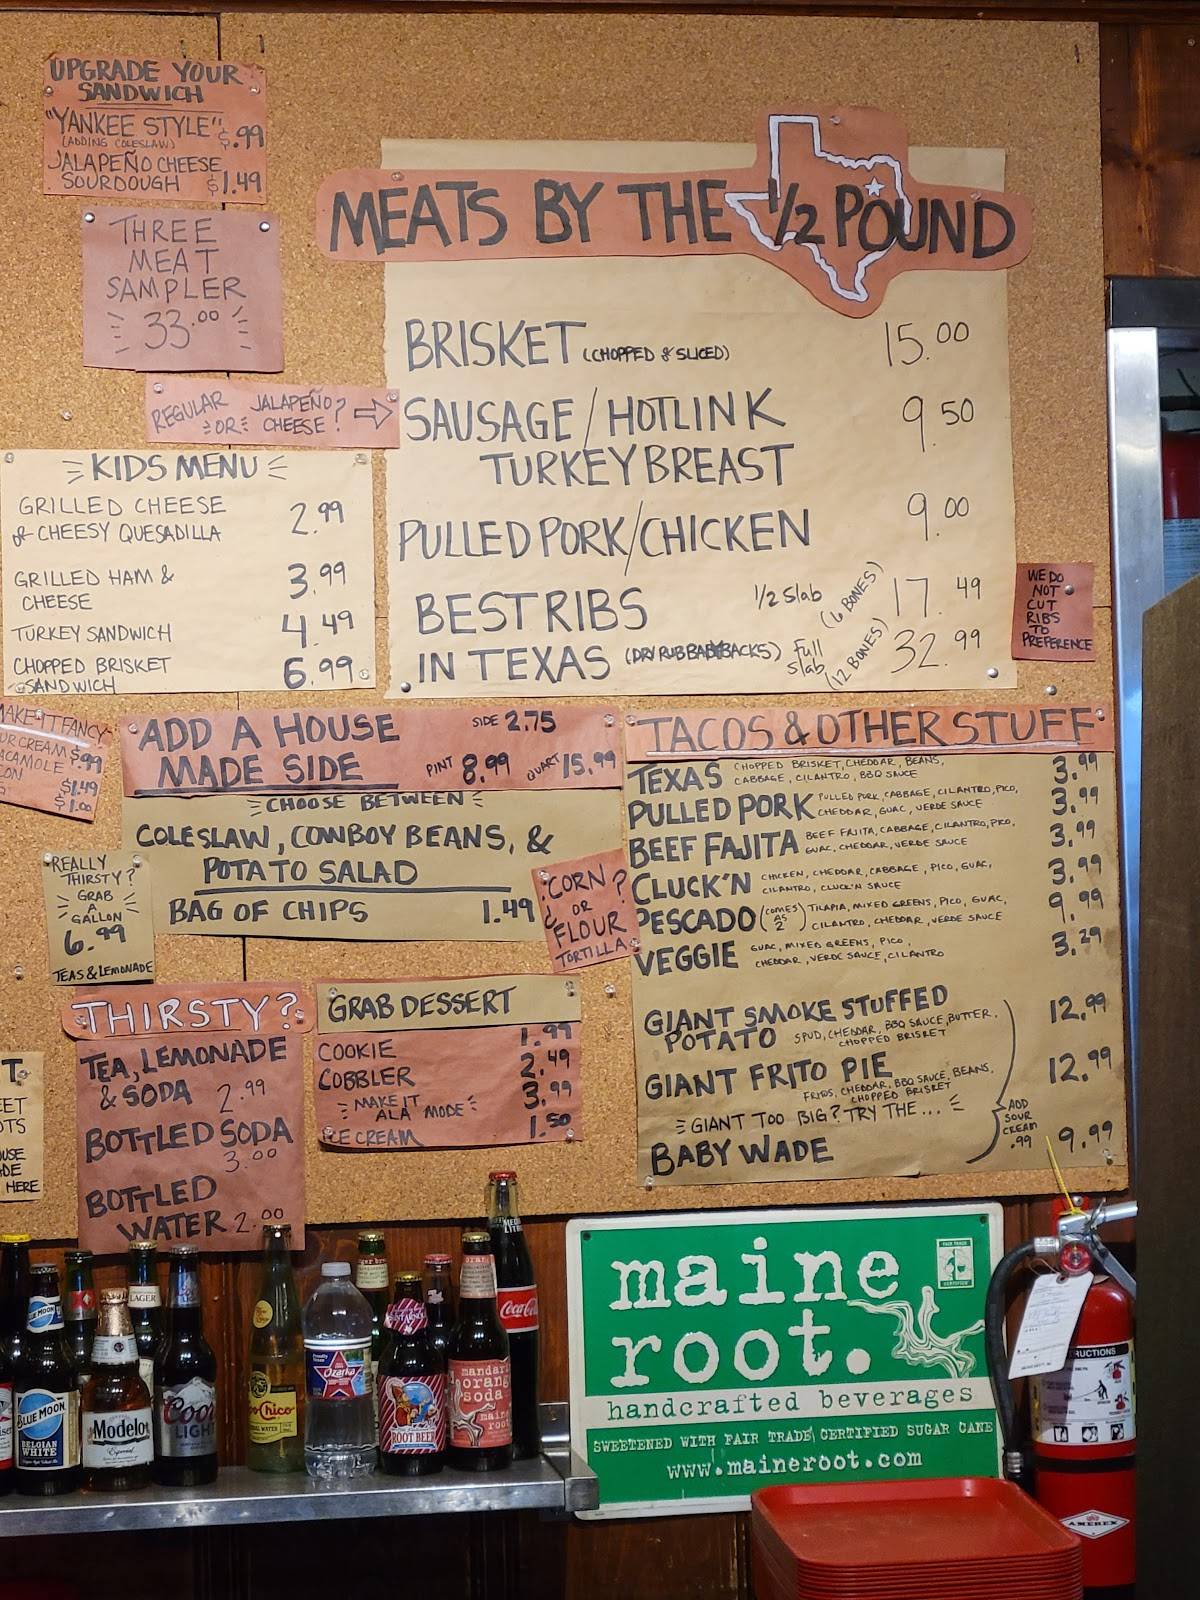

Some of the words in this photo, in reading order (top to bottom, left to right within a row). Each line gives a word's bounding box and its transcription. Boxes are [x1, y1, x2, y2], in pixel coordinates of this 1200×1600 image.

[50, 59, 160, 83] UPGRADE
[171, 60, 243, 85] YOUR
[78, 82, 204, 104] SANDWICH
[157, 155, 222, 173] CHEESE
[62, 172, 180, 192] SOURDOUGH
[108, 213, 217, 245] THREE
[330, 180, 508, 255] MEATS
[533, 178, 604, 244] BY
[617, 178, 732, 244] THE
[835, 184, 1016, 259] POUND
[129, 247, 220, 275] MEAT
[106, 275, 247, 304] SAMPLER
[405, 318, 588, 373] BRISKET
[151, 390, 230, 434] REGULAR
[91, 452, 168, 482] KIDS
[175, 455, 259, 482] MENU
[479, 443, 637, 488] TURKEY
[645, 442, 795, 487] BREAST
[19, 496, 123, 516] GRILLED
[134, 495, 227, 515] CHEESE
[289, 500, 345, 537] 2.99
[38, 521, 110, 543] CHEESY
[119, 522, 222, 543] QUESADILLA
[398, 518, 532, 562] PULLED
[14, 569, 101, 587] GRILLED
[107, 569, 155, 587] HAM
[159, 563, 175, 585] &
[287, 560, 347, 600] 3.99
[1027, 570, 1048, 583] WE
[1048, 571, 1065, 584] DO
[21, 592, 94, 612] CHEESE
[1031, 584, 1057, 599] NOT
[415, 590, 539, 636] BEST
[545, 586, 648, 633] RIBS
[1026, 599, 1057, 612] CUT
[1026, 611, 1062, 625] RIBS
[11, 623, 82, 643] TURKEY
[87, 623, 173, 642] SANDWICH
[1029, 625, 1050, 635] TO
[13, 656, 86, 675] CHOPPED
[95, 656, 172, 675] BRISKET
[418, 650, 456, 684] IN
[467, 644, 611, 685] TEXAS
[659, 644, 686, 662] RUB
[138, 717, 213, 753] ADD
[231, 717, 263, 753] A
[273, 712, 401, 748] HOUSE
[472, 714, 500, 729] SIDE
[504, 709, 557, 734] 2.75
[637, 714, 775, 754] TACOS
[784, 714, 811, 747] &
[816, 708, 948, 748] OTHER
[952, 706, 1096, 746] STUFF
[156, 754, 265, 790] MADE
[284, 751, 364, 783] SIDE
[426, 757, 455, 779] PINT
[461, 752, 511, 786] 8.99
[627, 761, 724, 796] TEXAS
[734, 760, 784, 772] CHOPPED
[885, 769, 919, 779] SAUCE
[265, 794, 347, 813] CHOOSE
[360, 790, 465, 812] BETWEEN
[627, 796, 733, 831] PULLED
[738, 792, 817, 826] PORK
[915, 800, 947, 812] VERDE
[950, 798, 984, 810] SAUCE
[526, 825, 554, 855] &
[628, 834, 698, 871] BEEF
[704, 828, 800, 868] FAJITA
[805, 829, 836, 841] BEEF
[893, 837, 930, 849] VERDE
[934, 837, 969, 847] SAUCE
[52, 853, 107, 873] REALLY
[203, 858, 308, 886] POTATO
[319, 859, 419, 885] SALAD
[77, 889, 114, 902] GRAB
[631, 871, 751, 906] CLUCK'N
[866, 881, 902, 891] SAUCE
[71, 911, 123, 924] GALLON
[87, 903, 97, 914] A
[169, 897, 222, 926] BAG
[232, 899, 269, 923] OF
[283, 899, 369, 923] CHIPS
[482, 897, 536, 924] 1.49
[572, 899, 593, 916] OR
[636, 905, 757, 936] PESCADO
[852, 899, 889, 911] MIXED
[967, 911, 1003, 922] SAUCE
[553, 911, 628, 949] FLOUR
[555, 937, 628, 968] TORTILLA
[635, 940, 739, 977] VEGGIE
[785, 939, 822, 951] MIXED
[52, 967, 85, 983] TEAS
[86, 965, 99, 981] &
[327, 992, 396, 1024] GRAB
[400, 984, 518, 1020] DESSERT
[643, 1005, 736, 1037] GIANT
[744, 999, 837, 1028] SMOKE
[841, 983, 949, 1019] STUFFED
[317, 1038, 398, 1062] COOKIE
[664, 1026, 777, 1055] POTATO
[140, 1036, 288, 1074] LEMONADE
[317, 1065, 417, 1092] COBBLER
[645, 1067, 738, 1101] GIANT
[749, 1058, 828, 1091] FRITO
[841, 1050, 893, 1083] PIE
[100, 1083, 118, 1111] &
[122, 1079, 193, 1109] SODA
[353, 1095, 398, 1113] MAKE
[402, 1094, 421, 1109] IT
[851, 1090, 899, 1104] CHOPPED
[1008, 1099, 1029, 1111] ADD
[374, 1107, 412, 1123] ALA
[690, 1113, 746, 1134] GIANT
[751, 1111, 785, 1129] TOO
[843, 1105, 877, 1123] TRY
[1002, 1121, 1038, 1136] CREAM
[1004, 1110, 1033, 1122] SOUR
[84, 1121, 215, 1164] BOTTLED
[220, 1116, 295, 1149] SODA
[650, 1137, 732, 1177] BABY
[738, 1133, 834, 1165] WADE
[6, 1180, 41, 1194] HERE
[84, 1174, 218, 1220] BOTTLED
[116, 1210, 228, 1242] WATER
[608, 1236, 901, 1312] maine
[129, 1293, 157, 1303] LAGER
[323, 1367, 356, 1378] Ozarka
[463, 1389, 503, 1402] soda
[607, 1390, 801, 1422] handcrafted
[819, 1383, 974, 1412] beverages
[16, 1412, 39, 1430] BLUE
[38, 1401, 66, 1419] MOON
[259, 1400, 295, 1420] Chico
[93, 1417, 147, 1440] Modelo
[392, 1431, 414, 1443] ROOT
[592, 1436, 674, 1454] SWEETENED
[680, 1433, 718, 1449] WITH
[724, 1431, 760, 1447] FAIR
[767, 1427, 813, 1445] TRADE
[819, 1423, 900, 1442] CERTIFIED
[906, 1421, 951, 1438] SUGAR
[958, 1419, 994, 1436] CANE
[21, 1440, 58, 1449] BELGIAN
[21, 1447, 58, 1457] WHITE
[666, 1449, 924, 1481] www.maineroot.com
[1068, 1519, 1118, 1528] AMEREX
